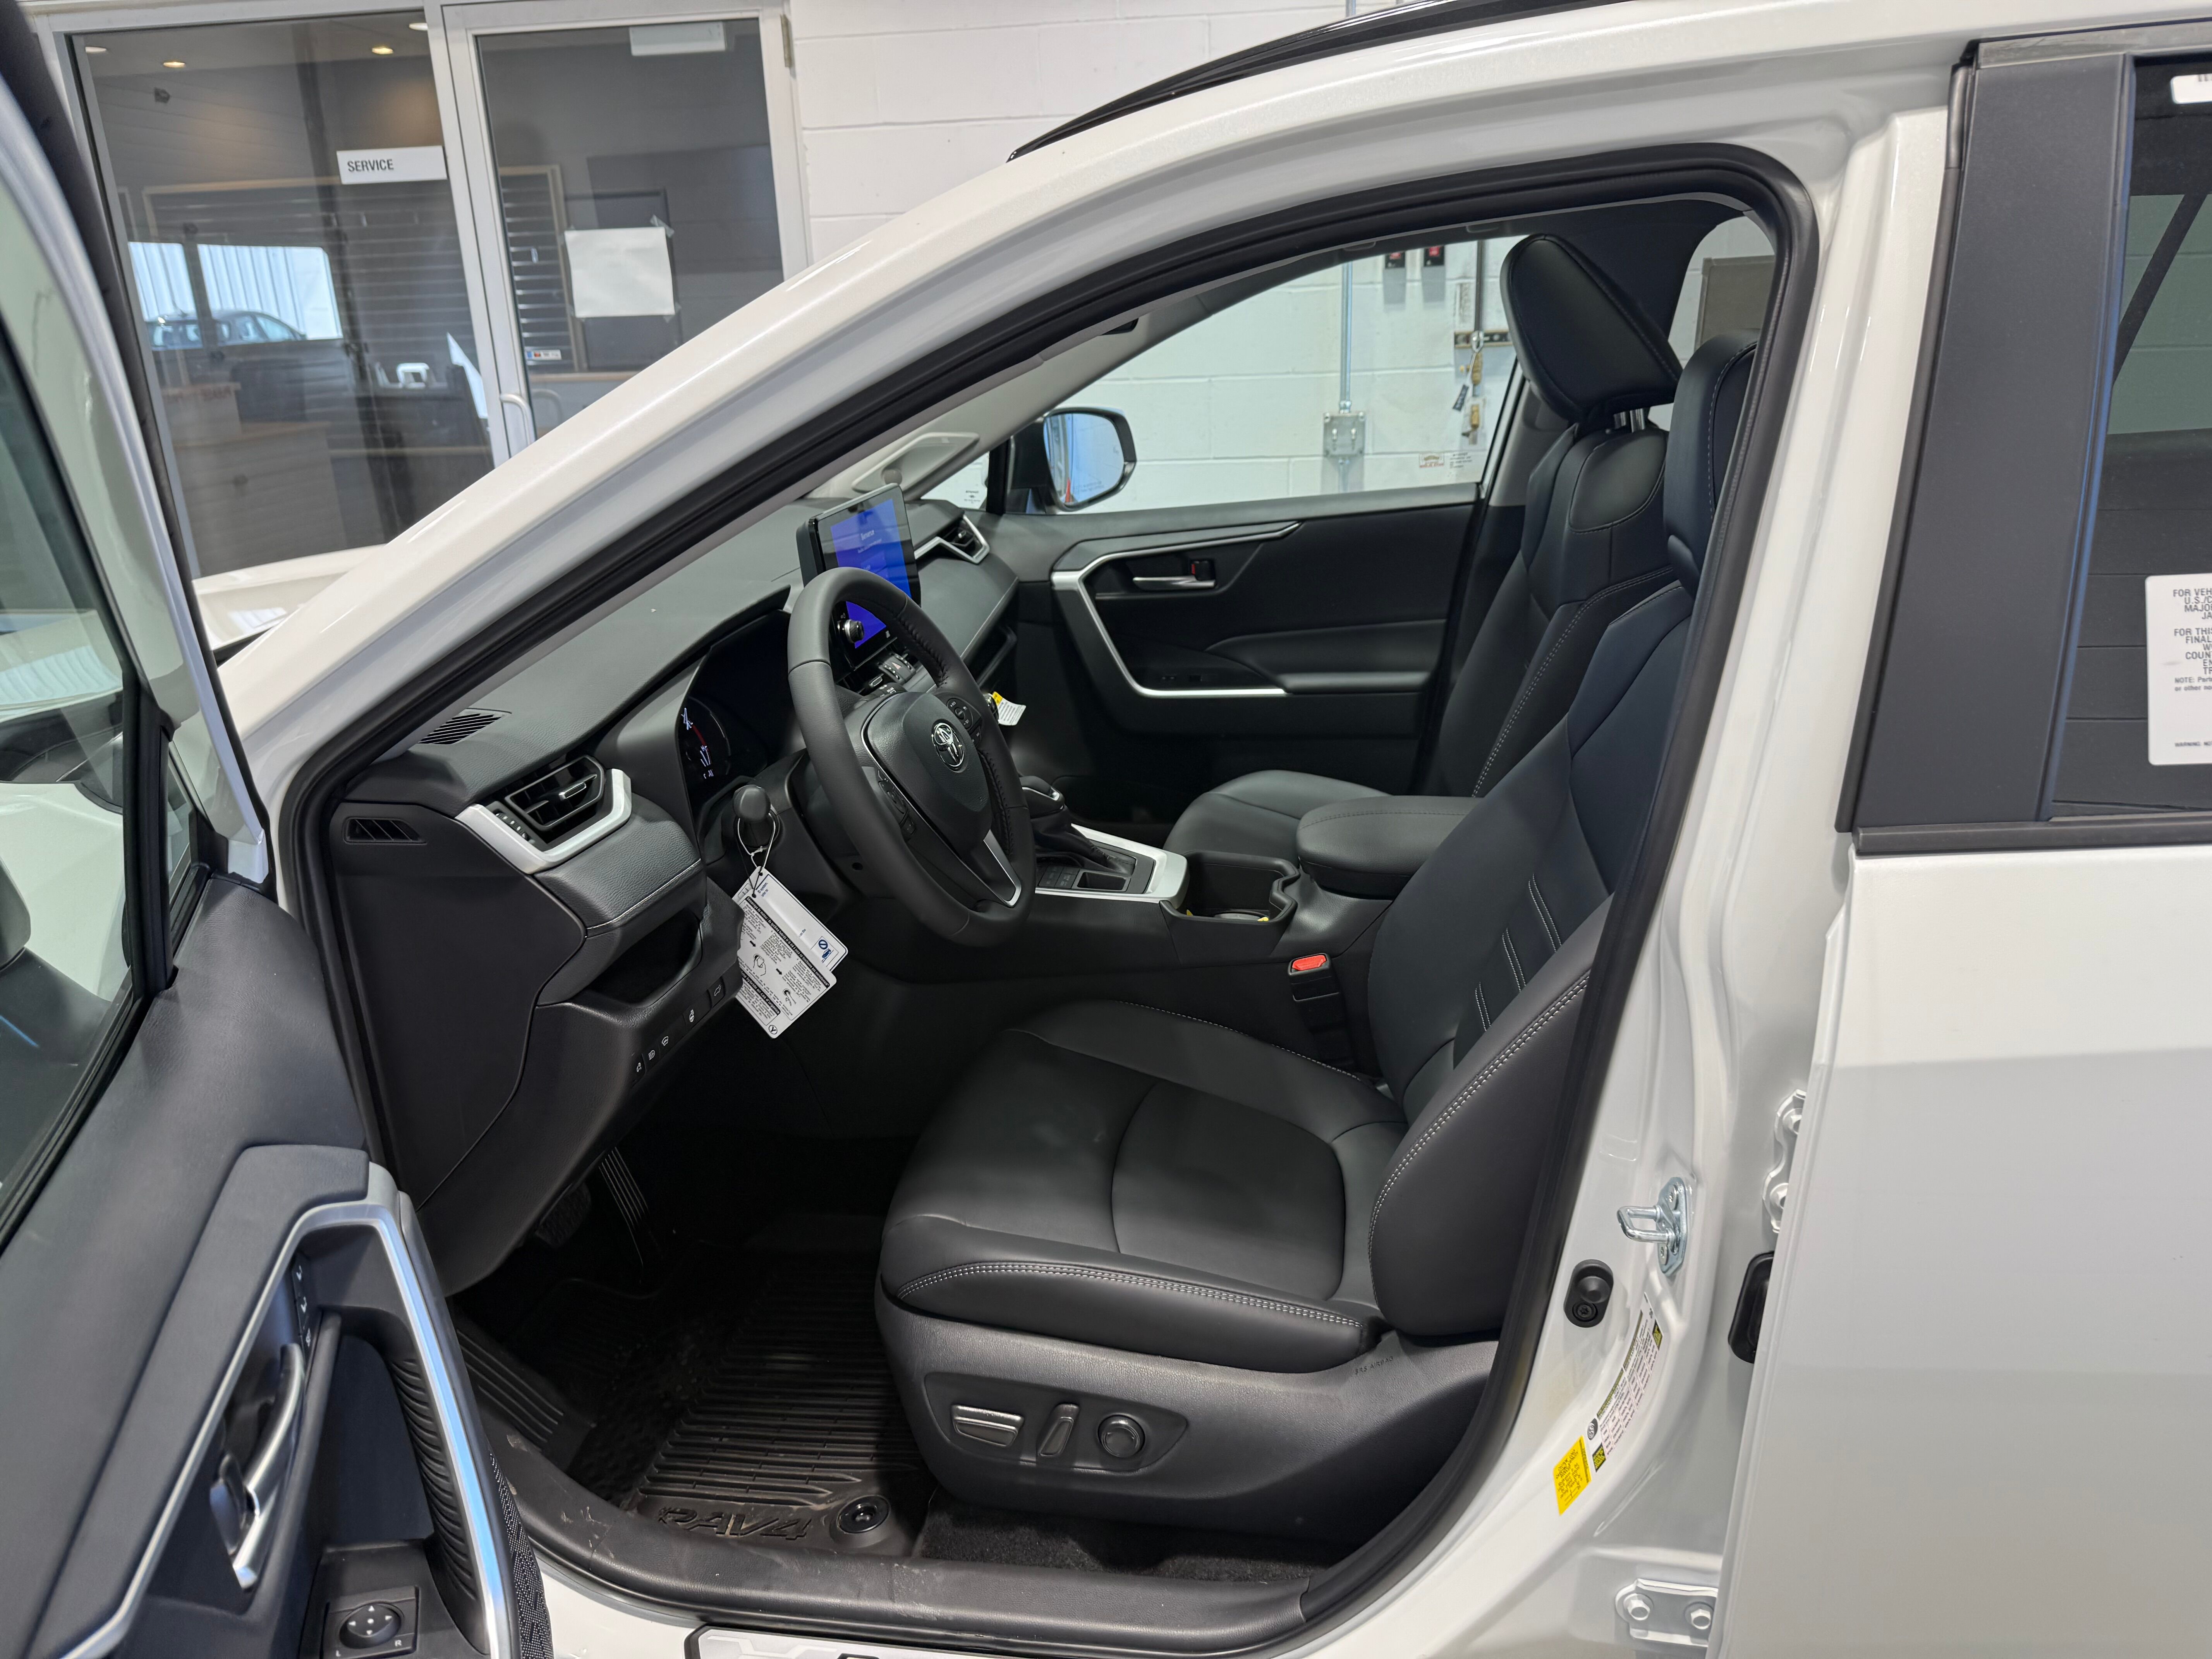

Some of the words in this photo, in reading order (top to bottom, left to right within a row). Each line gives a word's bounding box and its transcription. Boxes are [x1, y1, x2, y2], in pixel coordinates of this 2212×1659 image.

[347, 159, 394, 172] SERVICE
[2186, 651, 2212, 659] COUN
[658, 1507, 812, 1540] RAV4
